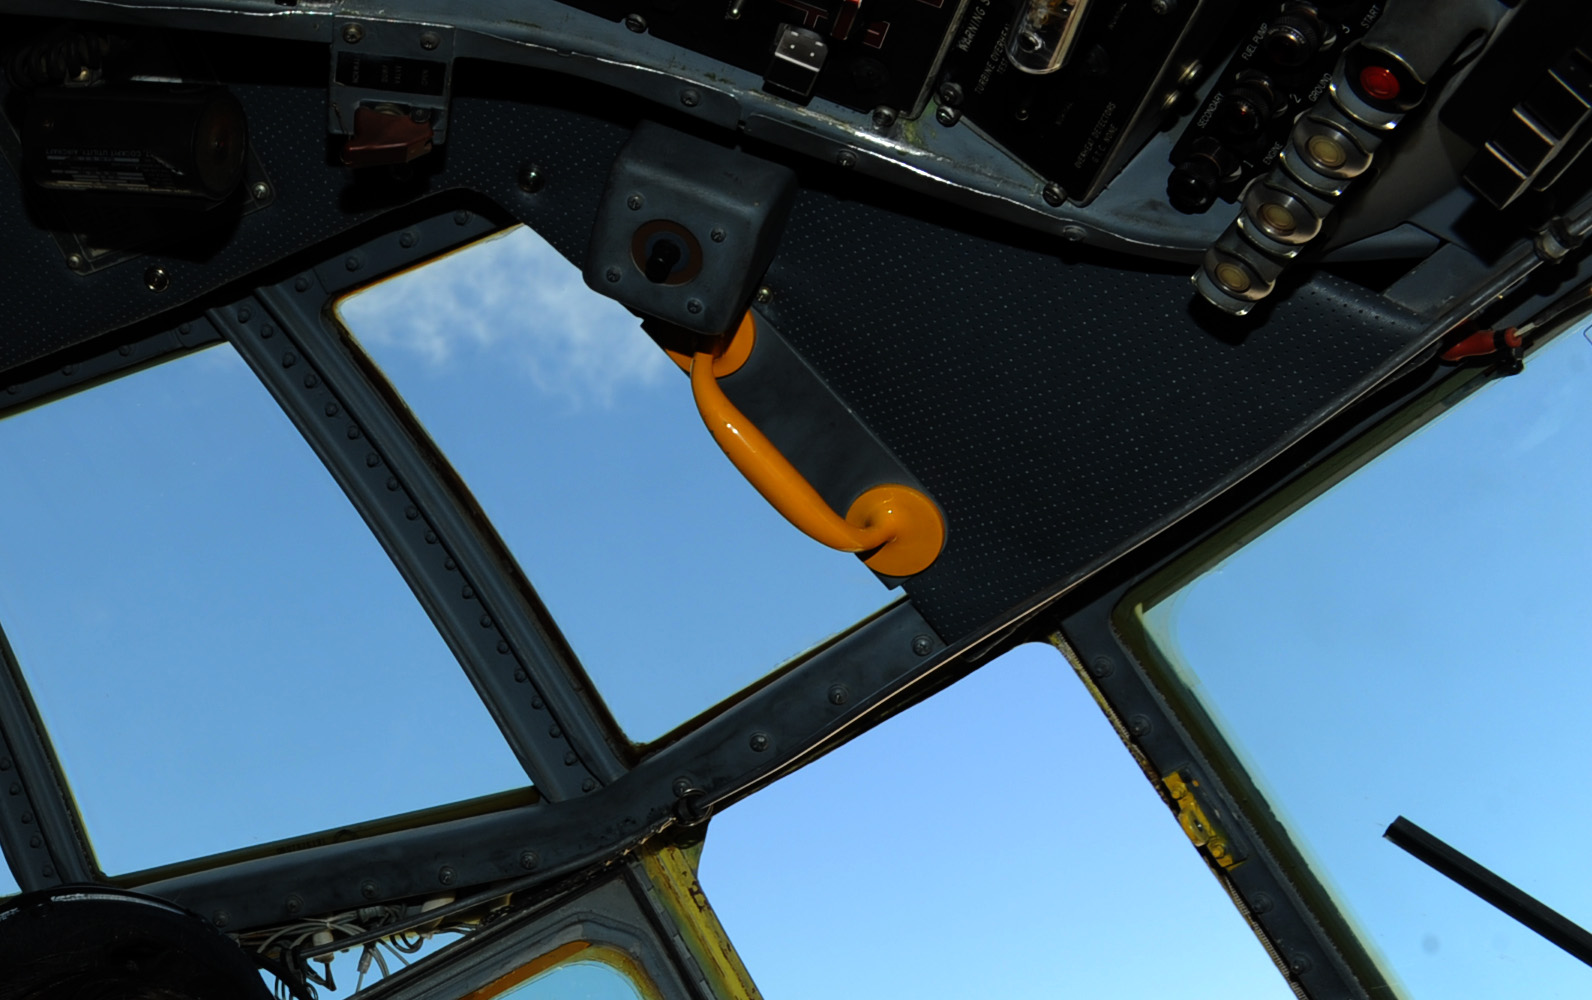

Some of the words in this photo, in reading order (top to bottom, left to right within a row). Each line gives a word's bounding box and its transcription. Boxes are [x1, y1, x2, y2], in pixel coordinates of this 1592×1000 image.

[958, 6, 986, 52] WARNING
[1241, 38, 1258, 61] FUEL
[1252, 22, 1270, 44] PUMP
[974, 59, 993, 95] TURBINE
[990, 23, 1008, 62] OVERHEA
[1308, 72, 1333, 103] GROUND
[1360, 4, 1381, 29] START
[1289, 93, 1302, 104] 2
